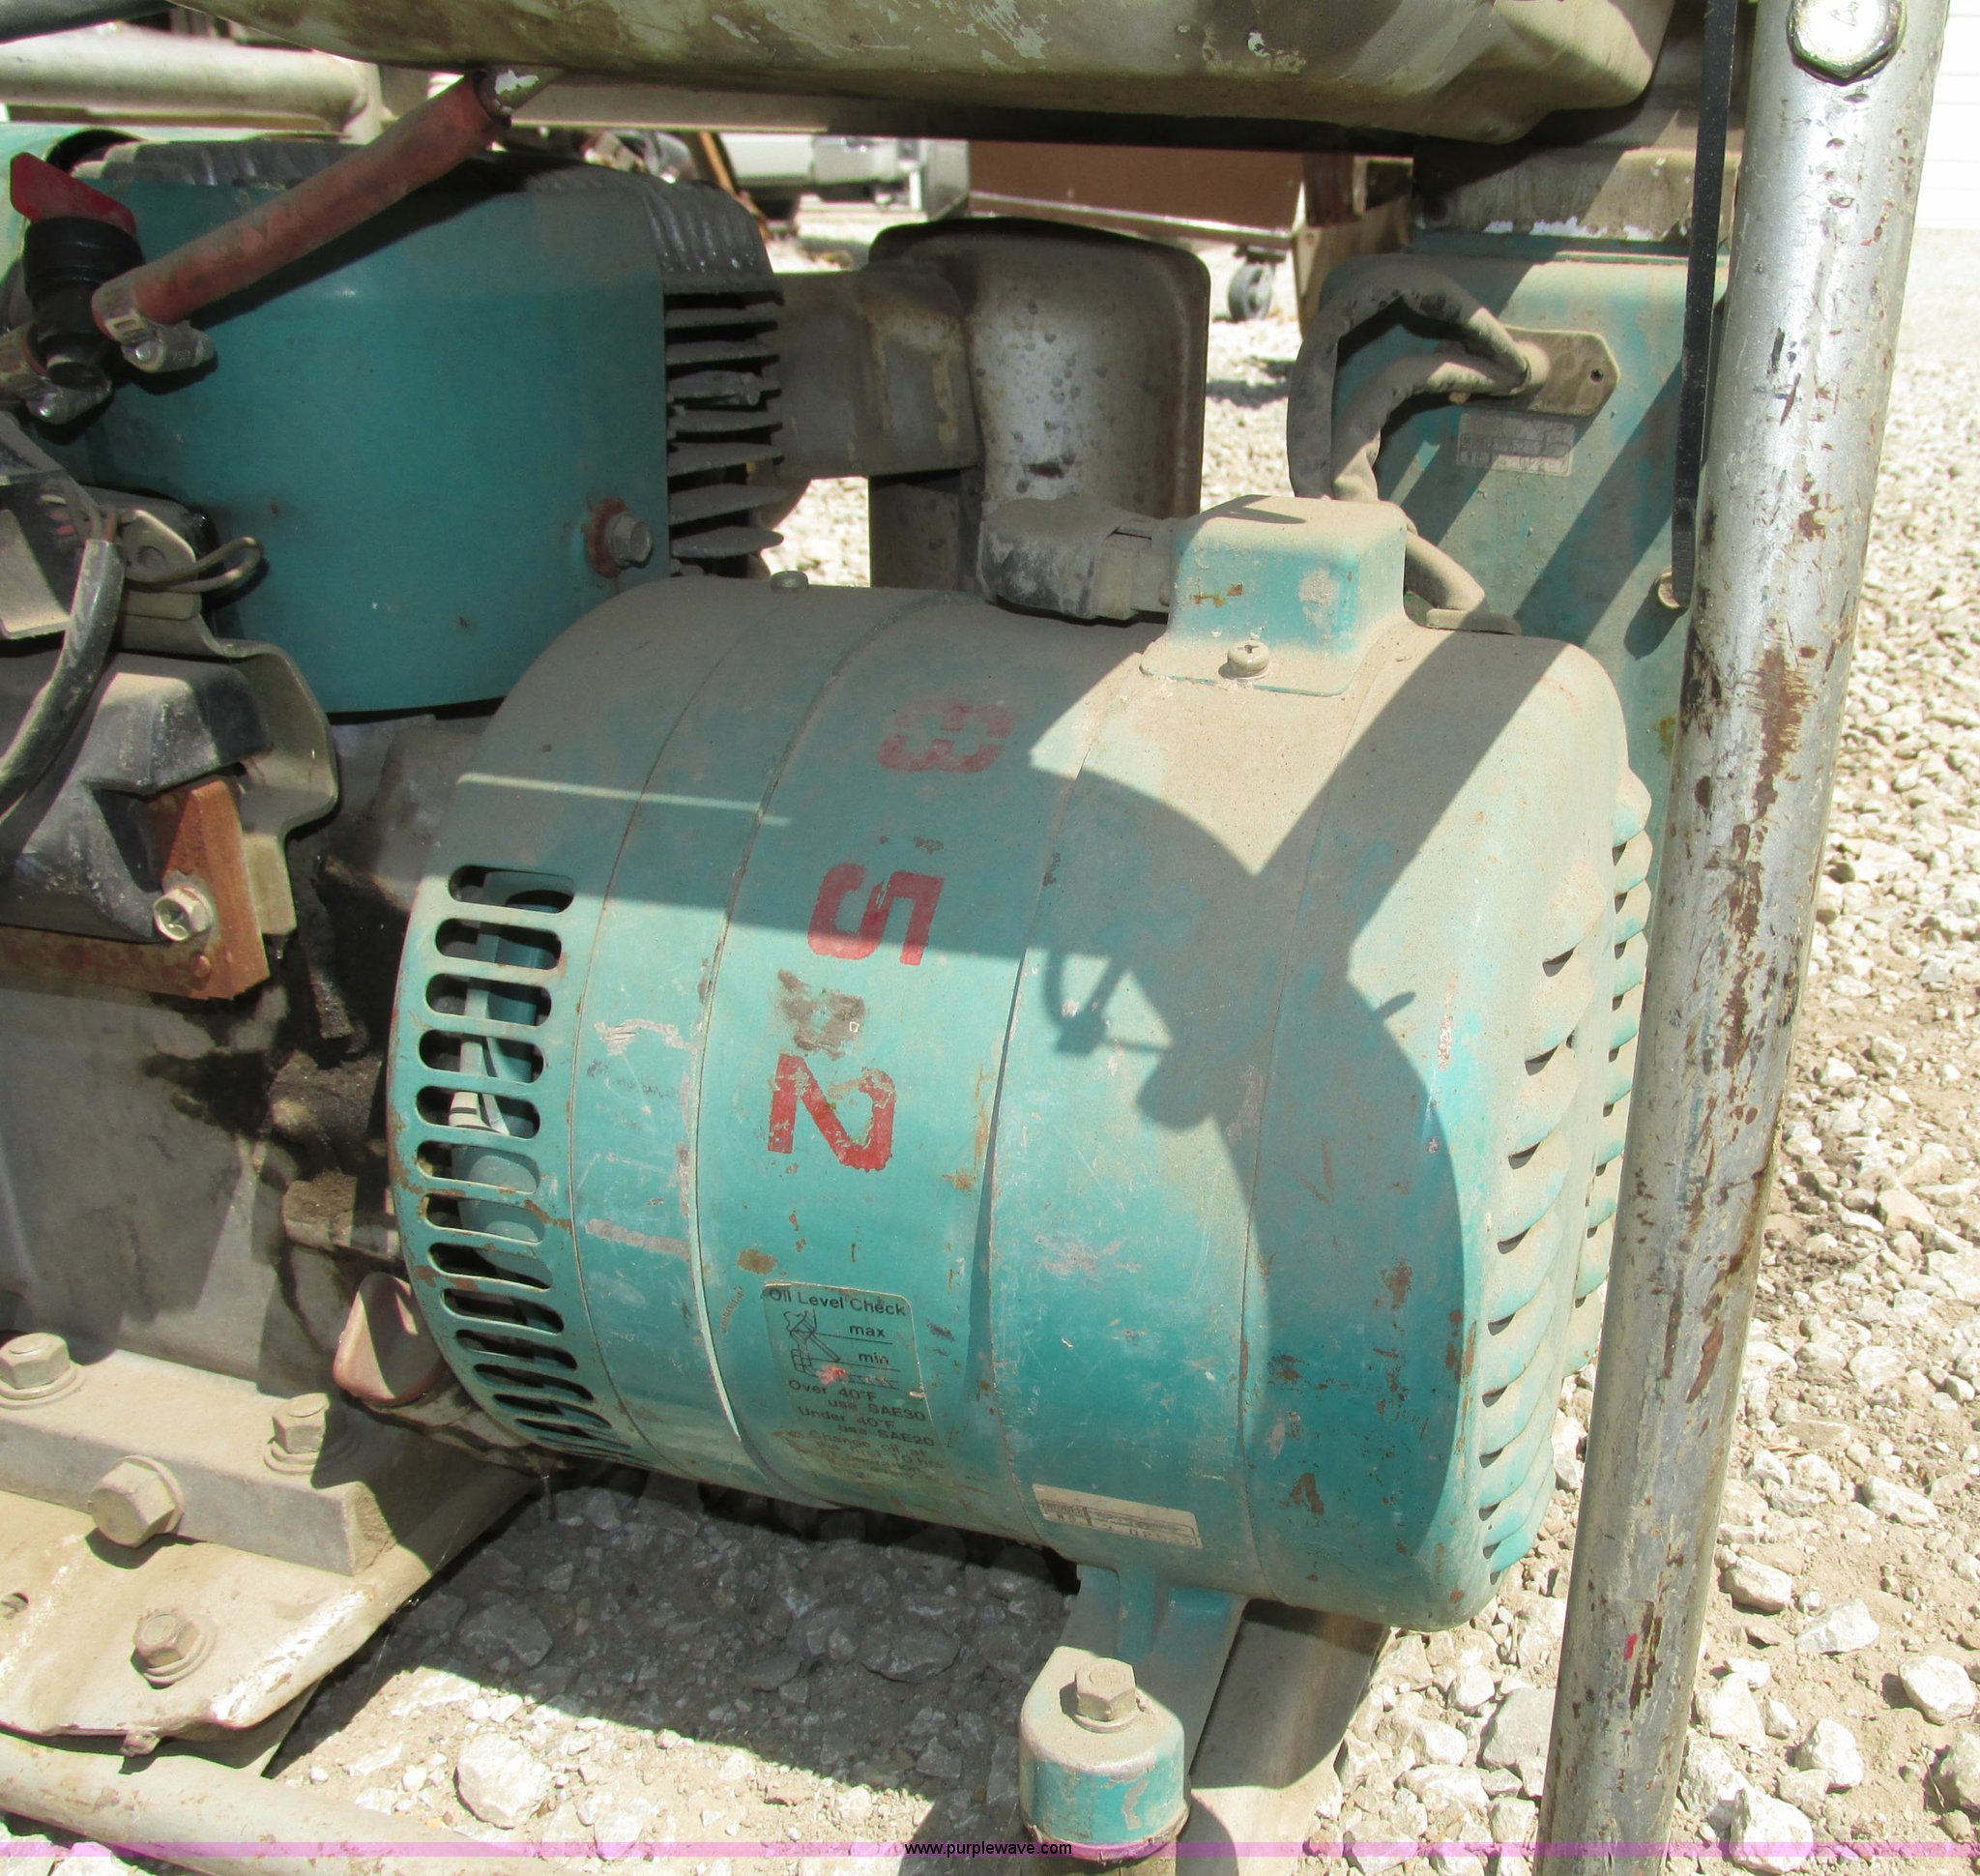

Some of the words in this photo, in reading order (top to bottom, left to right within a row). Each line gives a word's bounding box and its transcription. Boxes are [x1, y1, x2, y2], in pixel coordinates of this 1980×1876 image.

[806, 863, 945, 966] 5
[767, 1052, 898, 1173] 2
[769, 1288, 792, 1304] Oil
[798, 1291, 845, 1309] Level
[850, 1297, 907, 1316] Check
[849, 1324, 886, 1338] max
[859, 1352, 889, 1364] min
[789, 1379, 828, 1394] Over
[799, 1406, 846, 1422] Under
[829, 1400, 859, 1411] use
[867, 1403, 926, 1422] SAE30
[838, 1423, 867, 1435] use
[877, 1428, 935, 1447] SAE20
